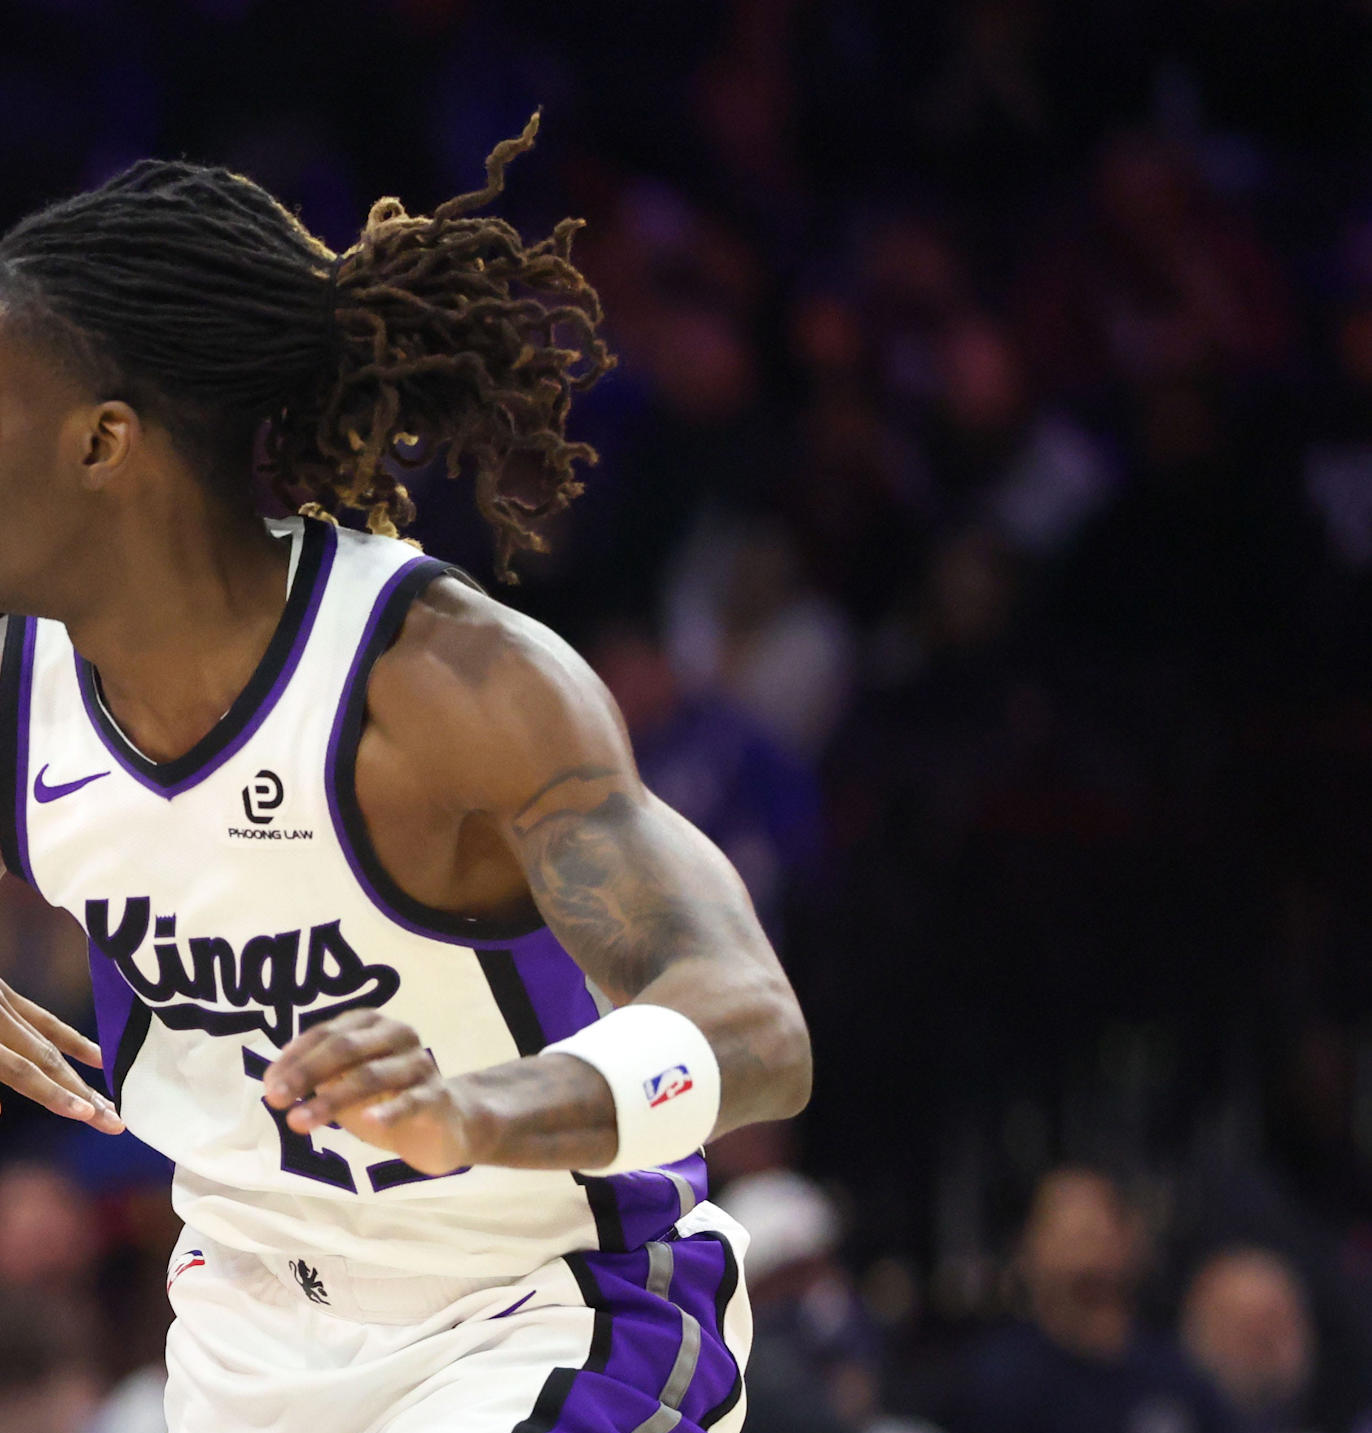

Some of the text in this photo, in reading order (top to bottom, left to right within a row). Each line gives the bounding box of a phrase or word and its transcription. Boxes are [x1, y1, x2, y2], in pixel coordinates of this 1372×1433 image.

[228, 828, 313, 840] PHOONG LAW
[85, 896, 402, 1052] Kings
